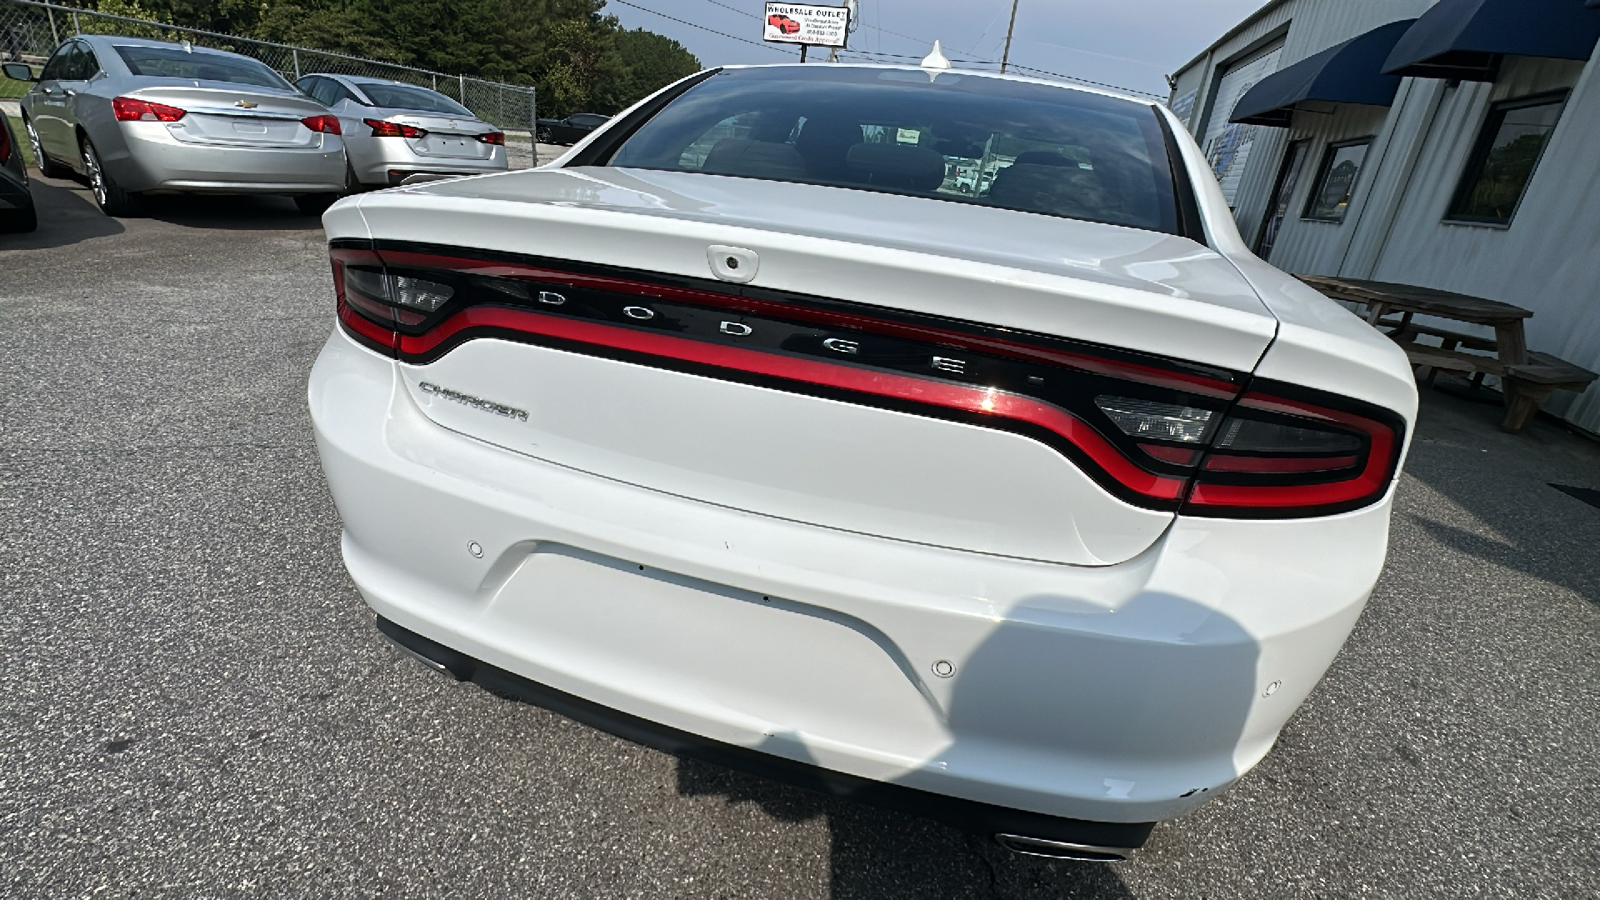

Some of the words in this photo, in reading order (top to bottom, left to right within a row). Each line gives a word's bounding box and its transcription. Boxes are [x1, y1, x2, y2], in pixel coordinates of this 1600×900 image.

[768, 6, 813, 16] WHOLESALE
[816, 9, 846, 18] OUTLET
[538, 291, 966, 374] DODGE
[418, 381, 530, 422] CHARGER
